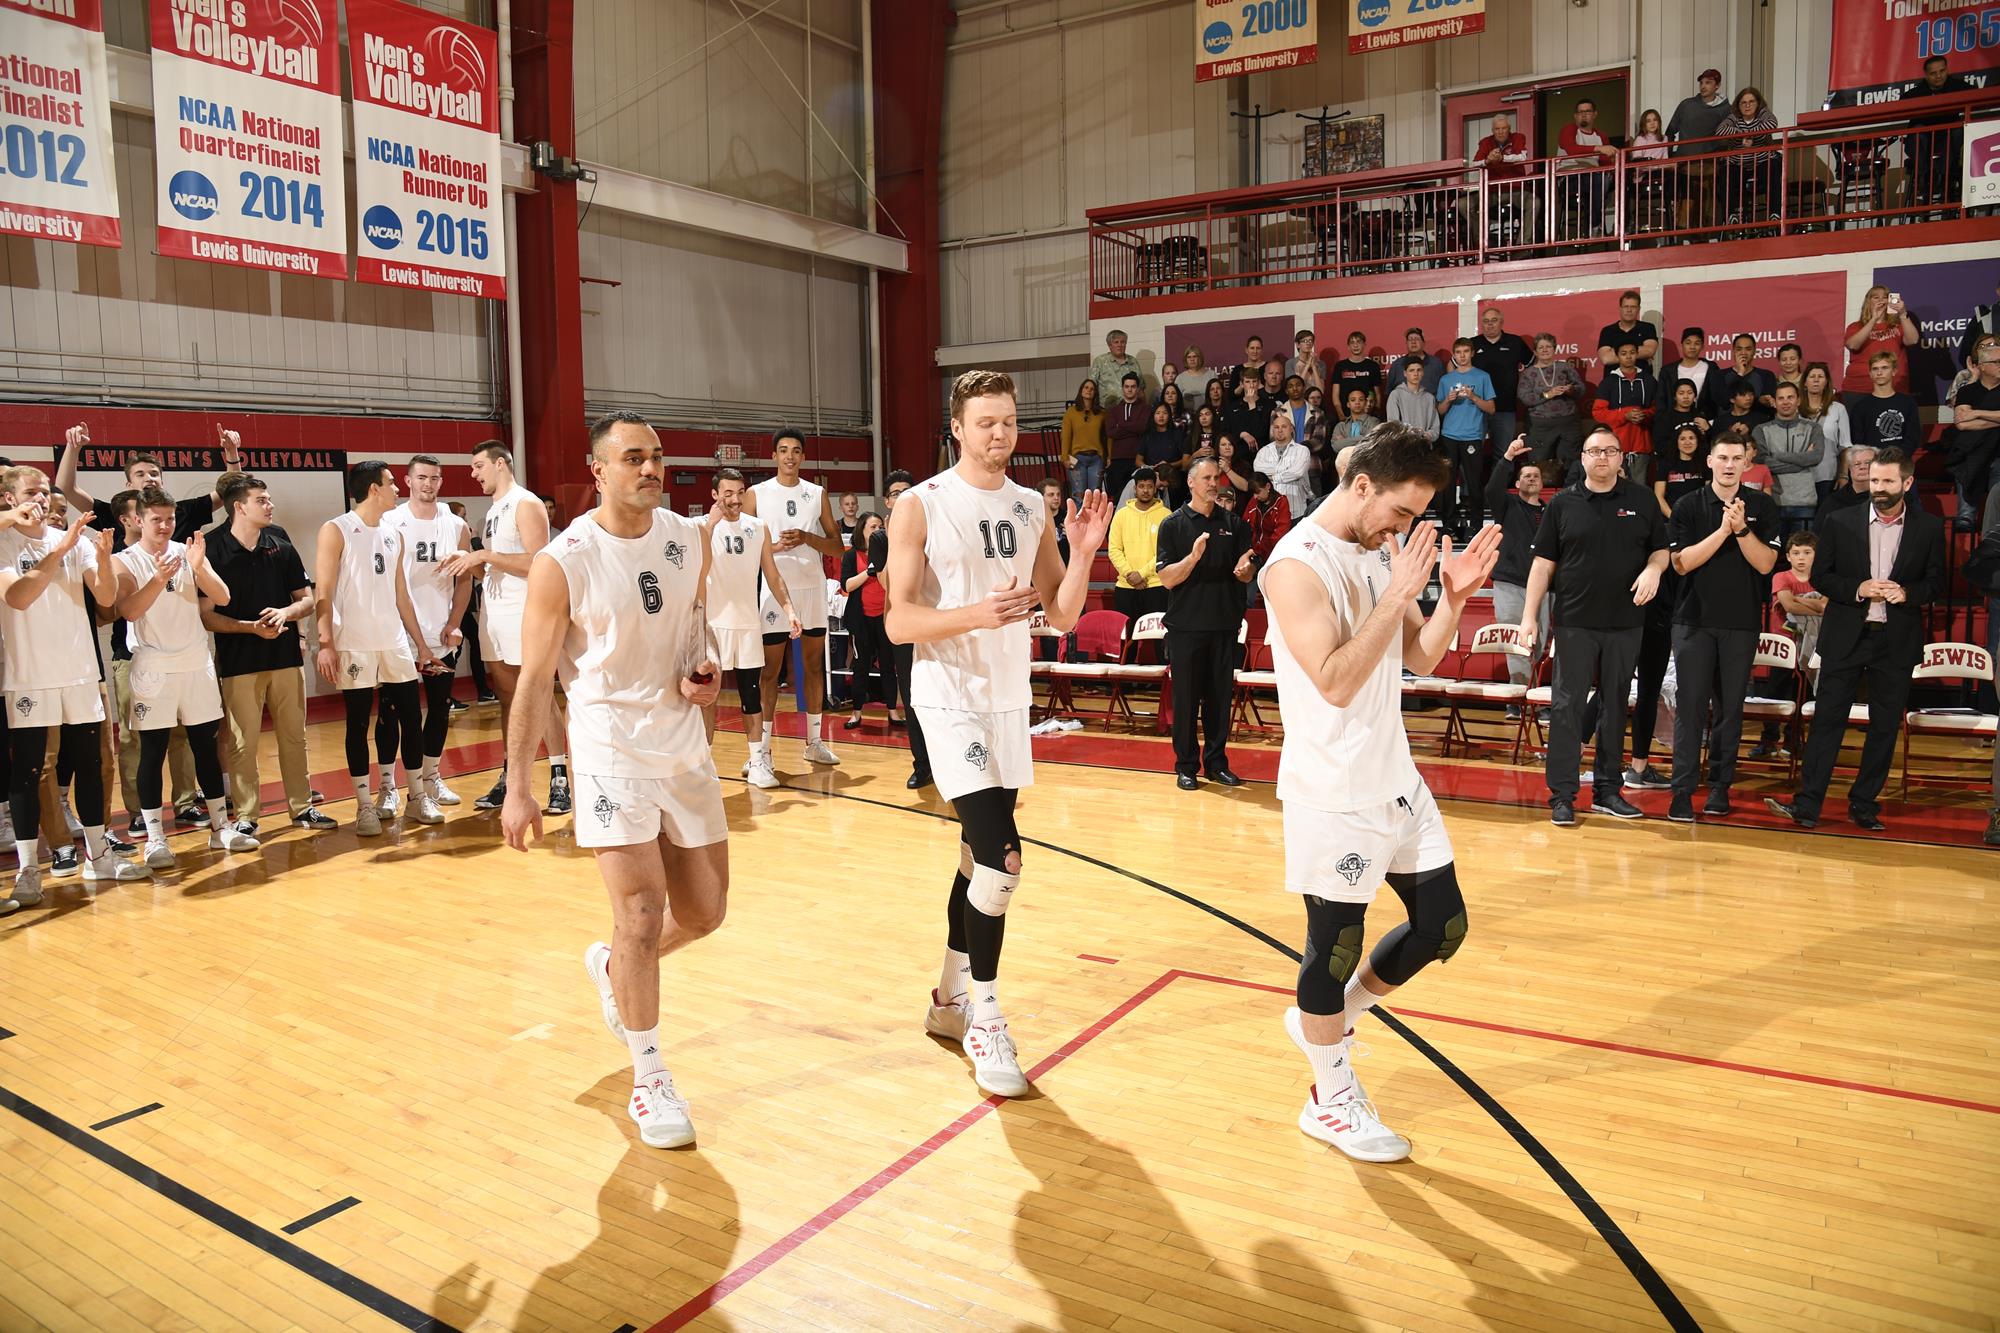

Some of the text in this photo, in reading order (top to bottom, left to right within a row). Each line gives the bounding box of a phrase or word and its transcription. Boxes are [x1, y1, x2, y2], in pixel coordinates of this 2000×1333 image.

[1242, 0, 1307, 37] 2000
[1360, 6, 1390, 20] NCAA
[171, 8, 318, 84] Volleyball
[1206, 35, 1232, 48] NCAA
[1367, 18, 1464, 48] Lewis University
[1915, 8, 2000, 59] 1965
[364, 32, 425, 76] Men's
[1212, 51, 1299, 77] Lewis University
[365, 62, 482, 125] Volleyball
[1856, 86, 1900, 106] Lewis
[179, 96, 320, 149] NCAA National
[0, 124, 88, 187] 012
[180, 127, 320, 176] Quarterfinalist
[368, 136, 487, 184] NCAA National
[174, 192, 217, 211] NCAA
[240, 171, 324, 228] 2014
[403, 170, 488, 209] Runner Up
[367, 225, 401, 241] NCAA
[416, 209, 488, 260] 2015
[192, 236, 319, 275] Lewis University
[382, 264, 483, 295] Lewis University
[1555, 343, 1579, 354] WIS
[1708, 330, 1796, 346] MAVILLE
[1706, 346, 1782, 361] UNIRSI
[786, 500, 797, 517] 8
[416, 541, 438, 562] 21
[725, 536, 744, 554] 13
[979, 520, 1017, 558] 10
[374, 553, 385, 574] 3
[638, 571, 663, 614] 6
[1478, 628, 1519, 646] LEWI
[1756, 638, 1790, 660] WIS
